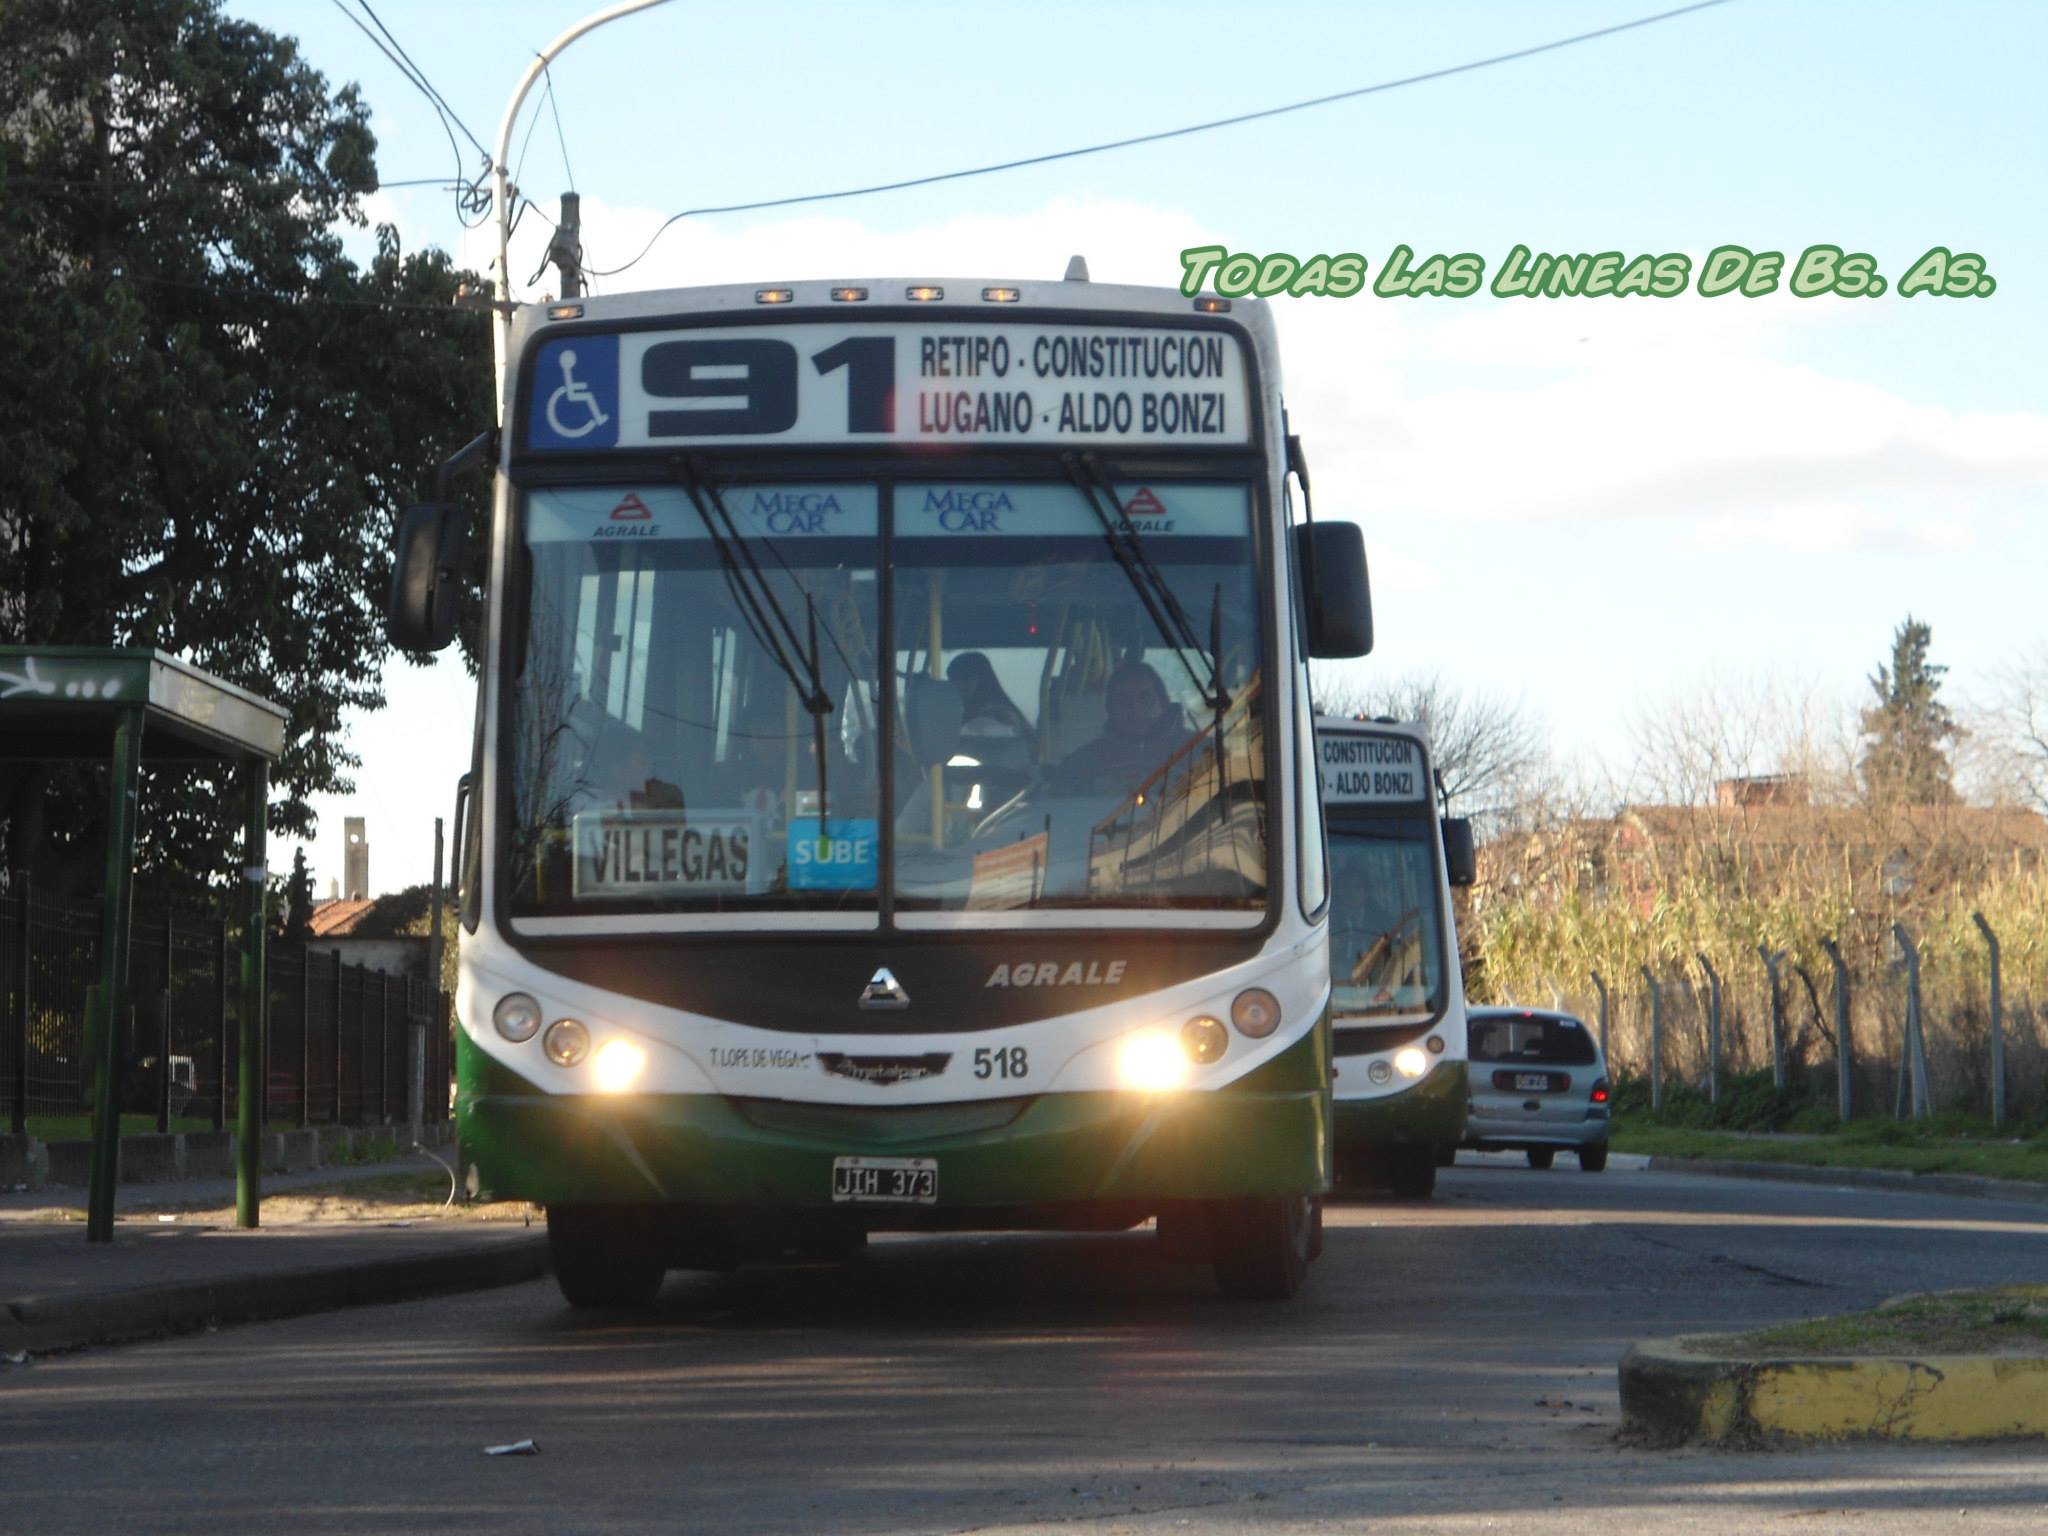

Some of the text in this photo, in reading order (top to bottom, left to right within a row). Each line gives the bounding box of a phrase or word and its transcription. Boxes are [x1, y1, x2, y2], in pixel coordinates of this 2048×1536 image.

[1033, 335, 1223, 378] CONSTITUCION
[641, 335, 896, 438] 91
[920, 391, 1224, 434] LUGANO ALDO BONZI
[752, 491, 842, 514] MEGA
[922, 489, 1016, 513] MEGA
[593, 524, 661, 538] AGRALE
[766, 512, 829, 534] CAR
[938, 510, 1002, 532] CAR
[1324, 740, 1412, 764] CONSTITUCION
[1337, 771, 1370, 794] ALDO
[1374, 771, 1413, 794] BONZI
[589, 825, 750, 883] VILLEGAS
[795, 838, 869, 865] SUBE
[984, 960, 1128, 988] AGRALE
[974, 1047, 1029, 1079] 518
[837, 1168, 934, 1196] JIH 373
